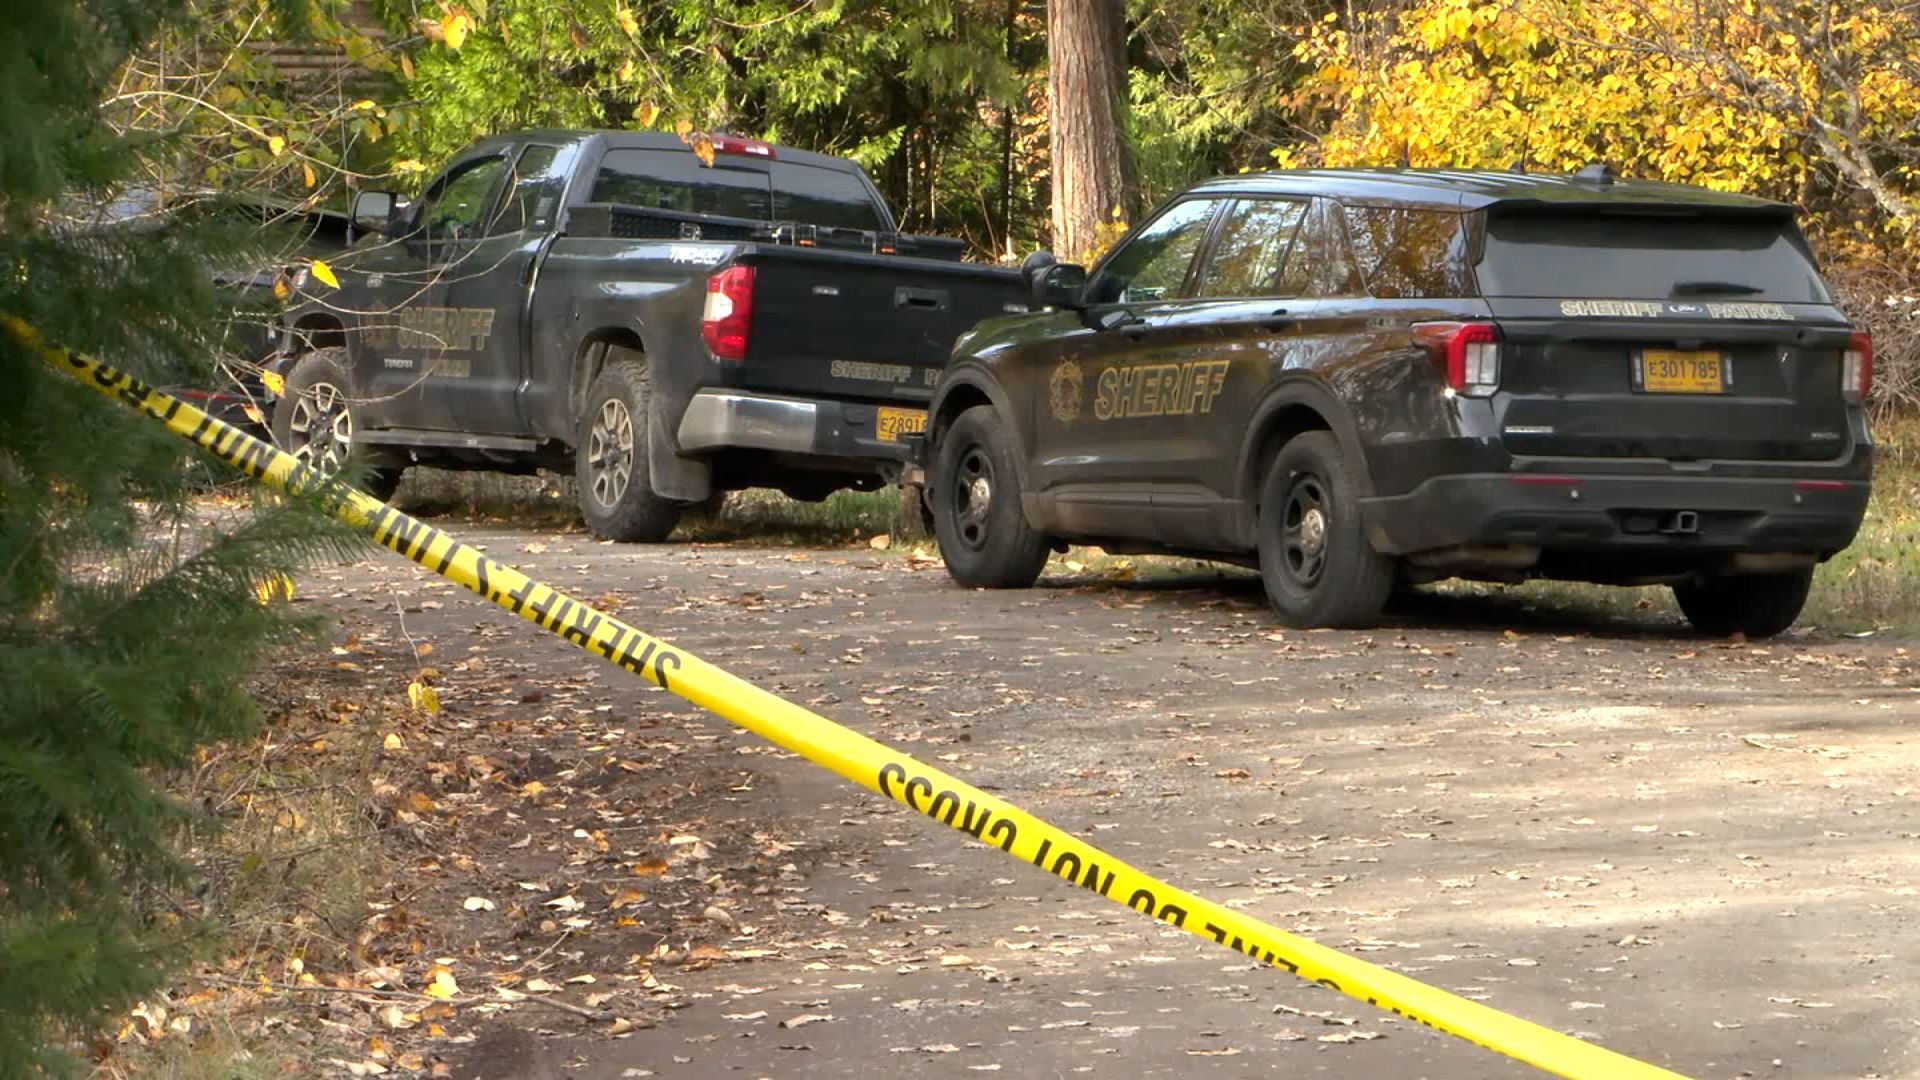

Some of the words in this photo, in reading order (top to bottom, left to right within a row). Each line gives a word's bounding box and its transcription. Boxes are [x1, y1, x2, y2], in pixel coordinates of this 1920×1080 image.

[1560, 301, 1663, 317] SHERIFF
[1706, 303, 1795, 320] PATROL
[397, 306, 496, 351] SHERIFF
[831, 360, 911, 382] SHERIFF
[1649, 359, 1718, 379] E301785
[1095, 360, 1231, 420] SHERIFF
[878, 762, 1017, 853] CROSS
